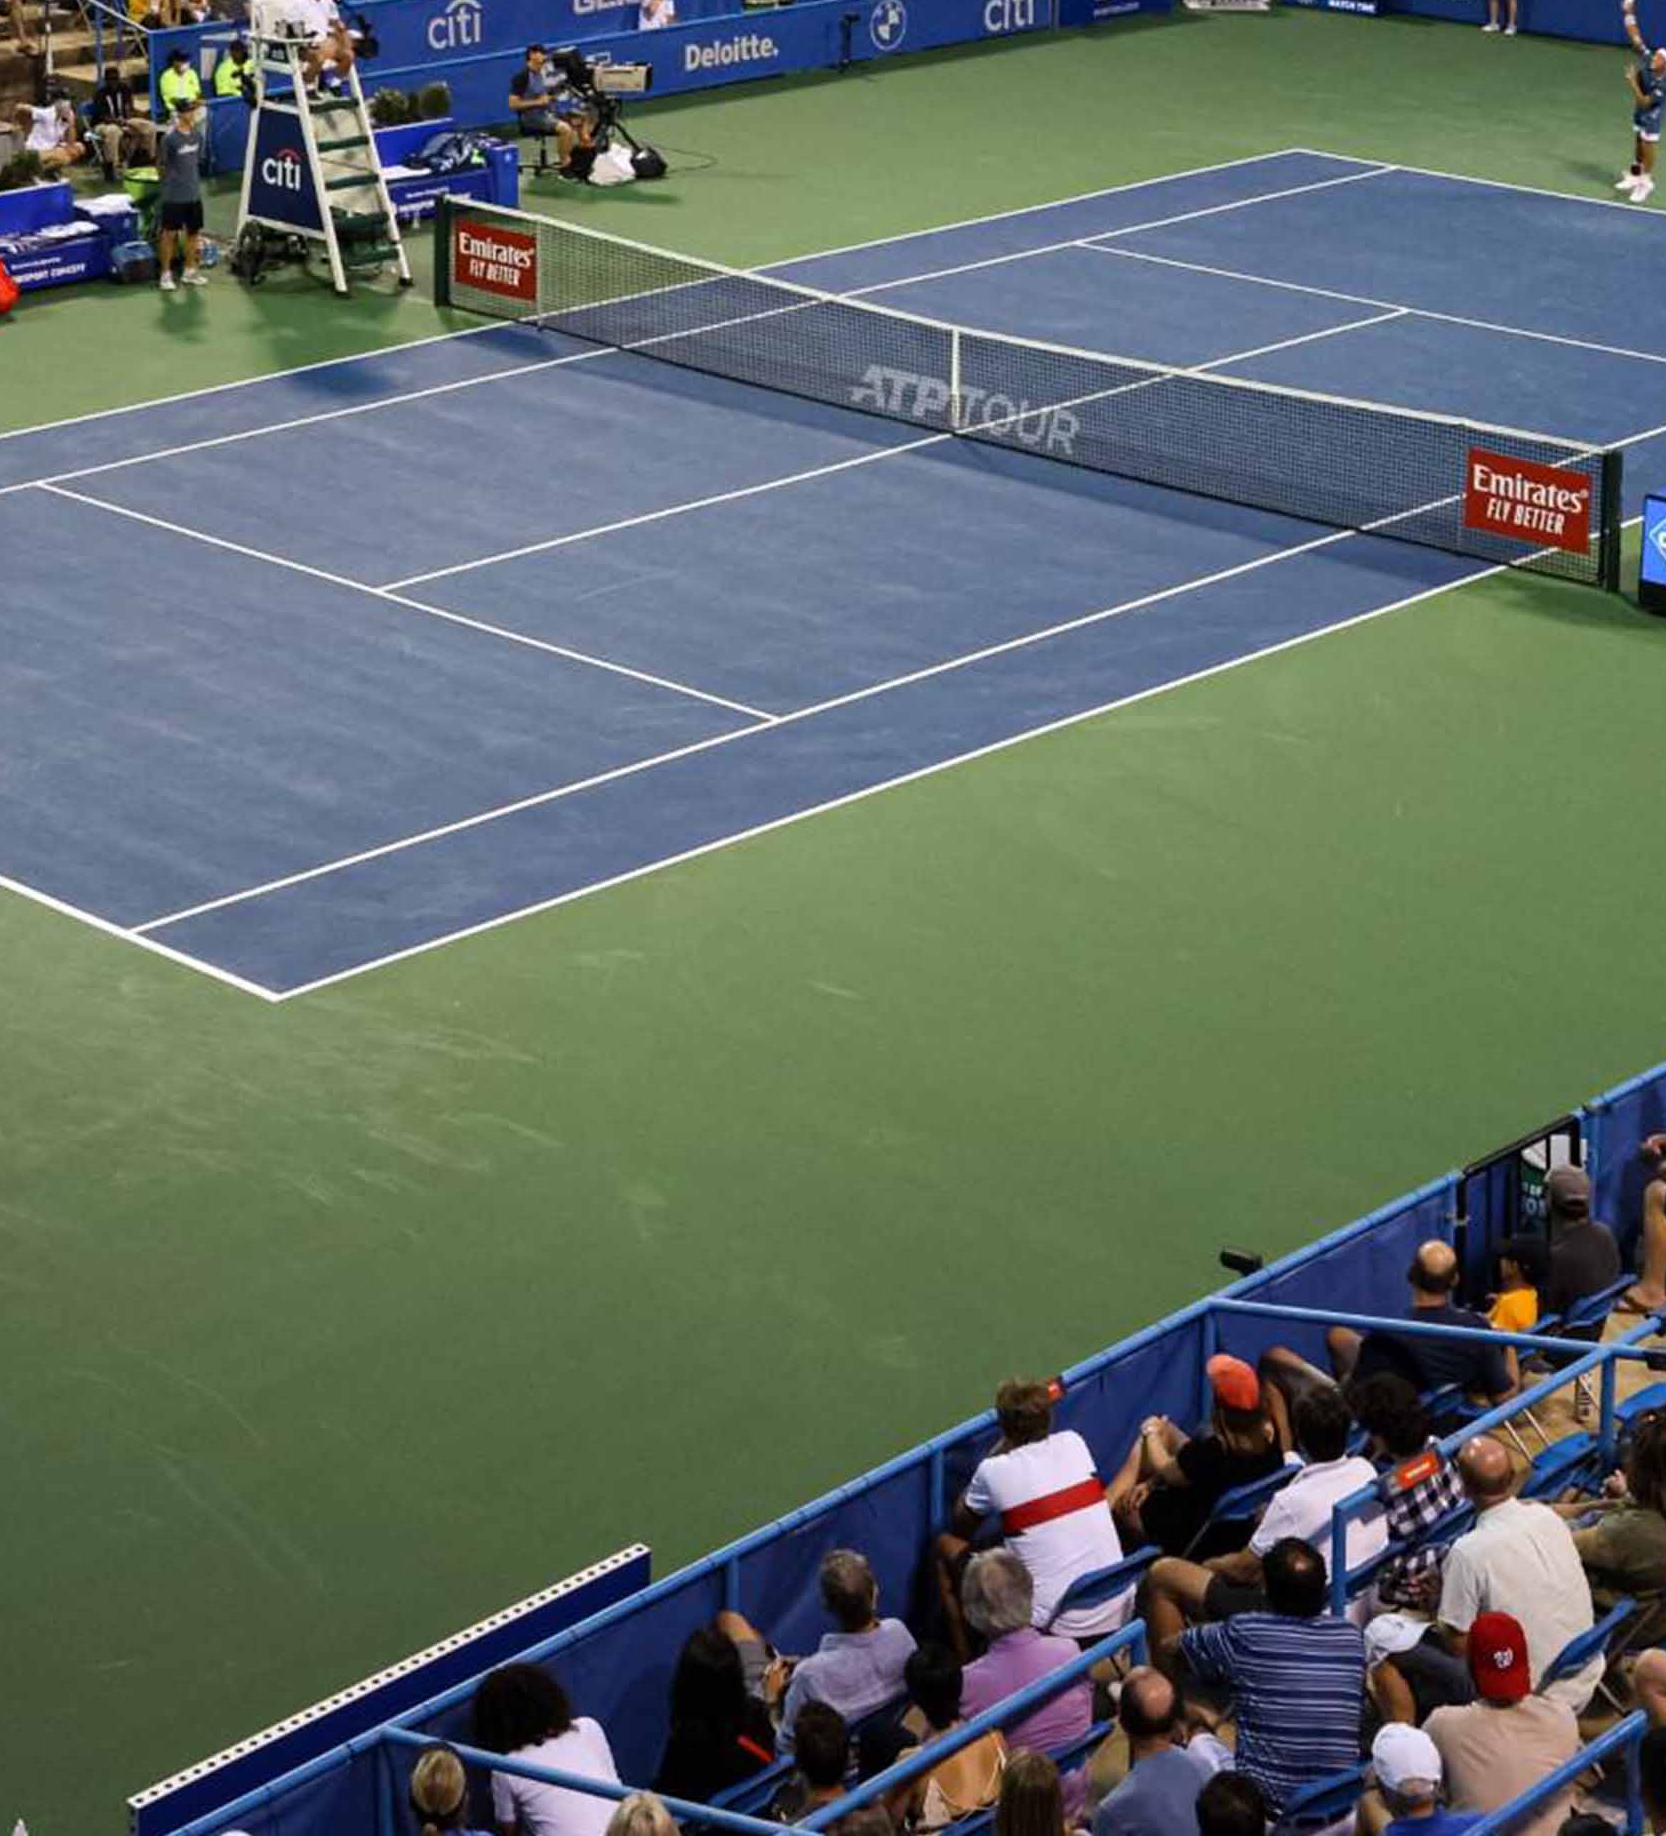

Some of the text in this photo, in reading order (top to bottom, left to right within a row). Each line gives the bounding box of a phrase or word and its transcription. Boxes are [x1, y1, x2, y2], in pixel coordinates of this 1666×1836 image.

[428, 1, 481, 50] citi
[684, 33, 779, 71] Deloitte.
[262, 151, 301, 191] citi
[458, 230, 533, 269] Emirates
[846, 364, 1082, 455] ATP TOUR
[1472, 463, 1585, 515] Emirates
[1486, 496, 1566, 536] FLY BETTER
